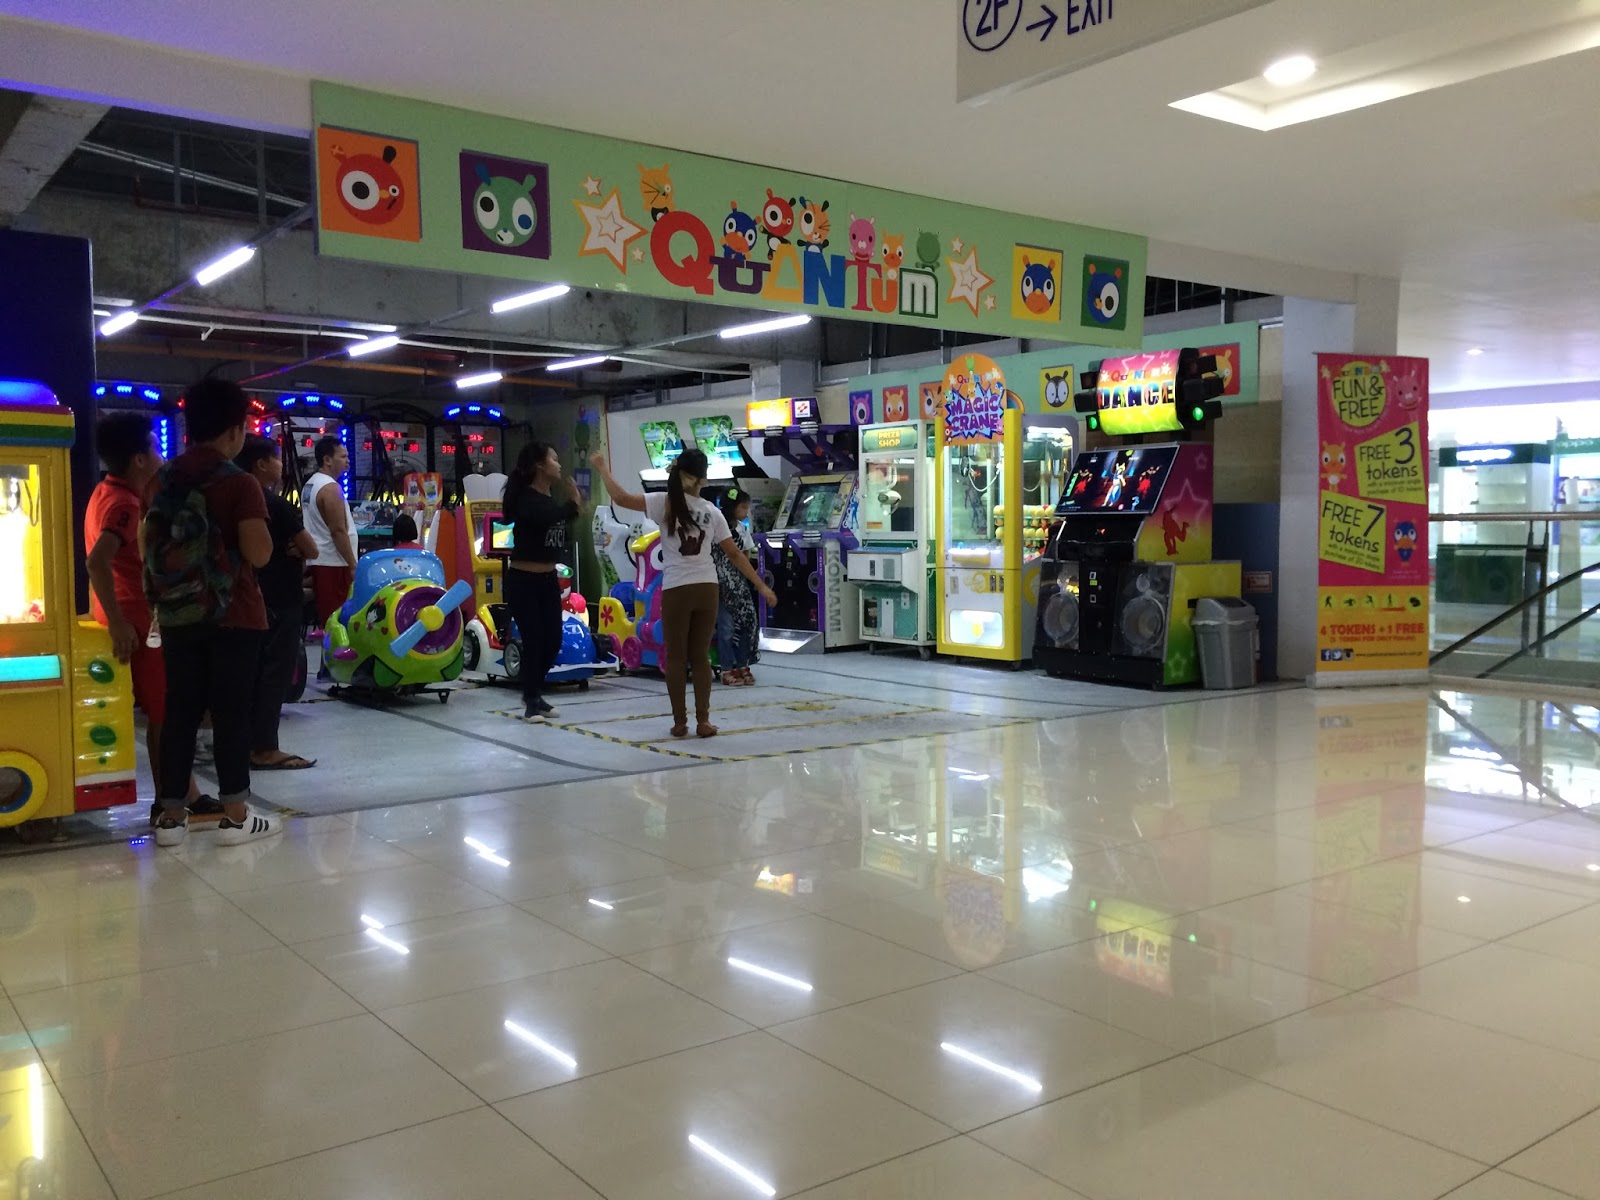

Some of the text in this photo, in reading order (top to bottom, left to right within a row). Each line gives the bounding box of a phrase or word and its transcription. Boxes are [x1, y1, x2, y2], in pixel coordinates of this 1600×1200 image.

[1096, 381, 1175, 410] DANCE
[1332, 378, 1366, 399] FUN
[951, 395, 999, 416] MAGIC
[1338, 397, 1380, 420] FREE
[951, 413, 998, 432] CRANE
[878, 439, 901, 448] SHOP
[1359, 427, 1415, 464] FREE 3
[1366, 462, 1418, 480] tokens
[1322, 500, 1385, 537] FREE 7
[1329, 525, 1380, 553] tokens
[827, 549, 841, 632] KONAMI
[1329, 624, 1376, 635] TOKENS
[1395, 623, 1425, 634] FREE
